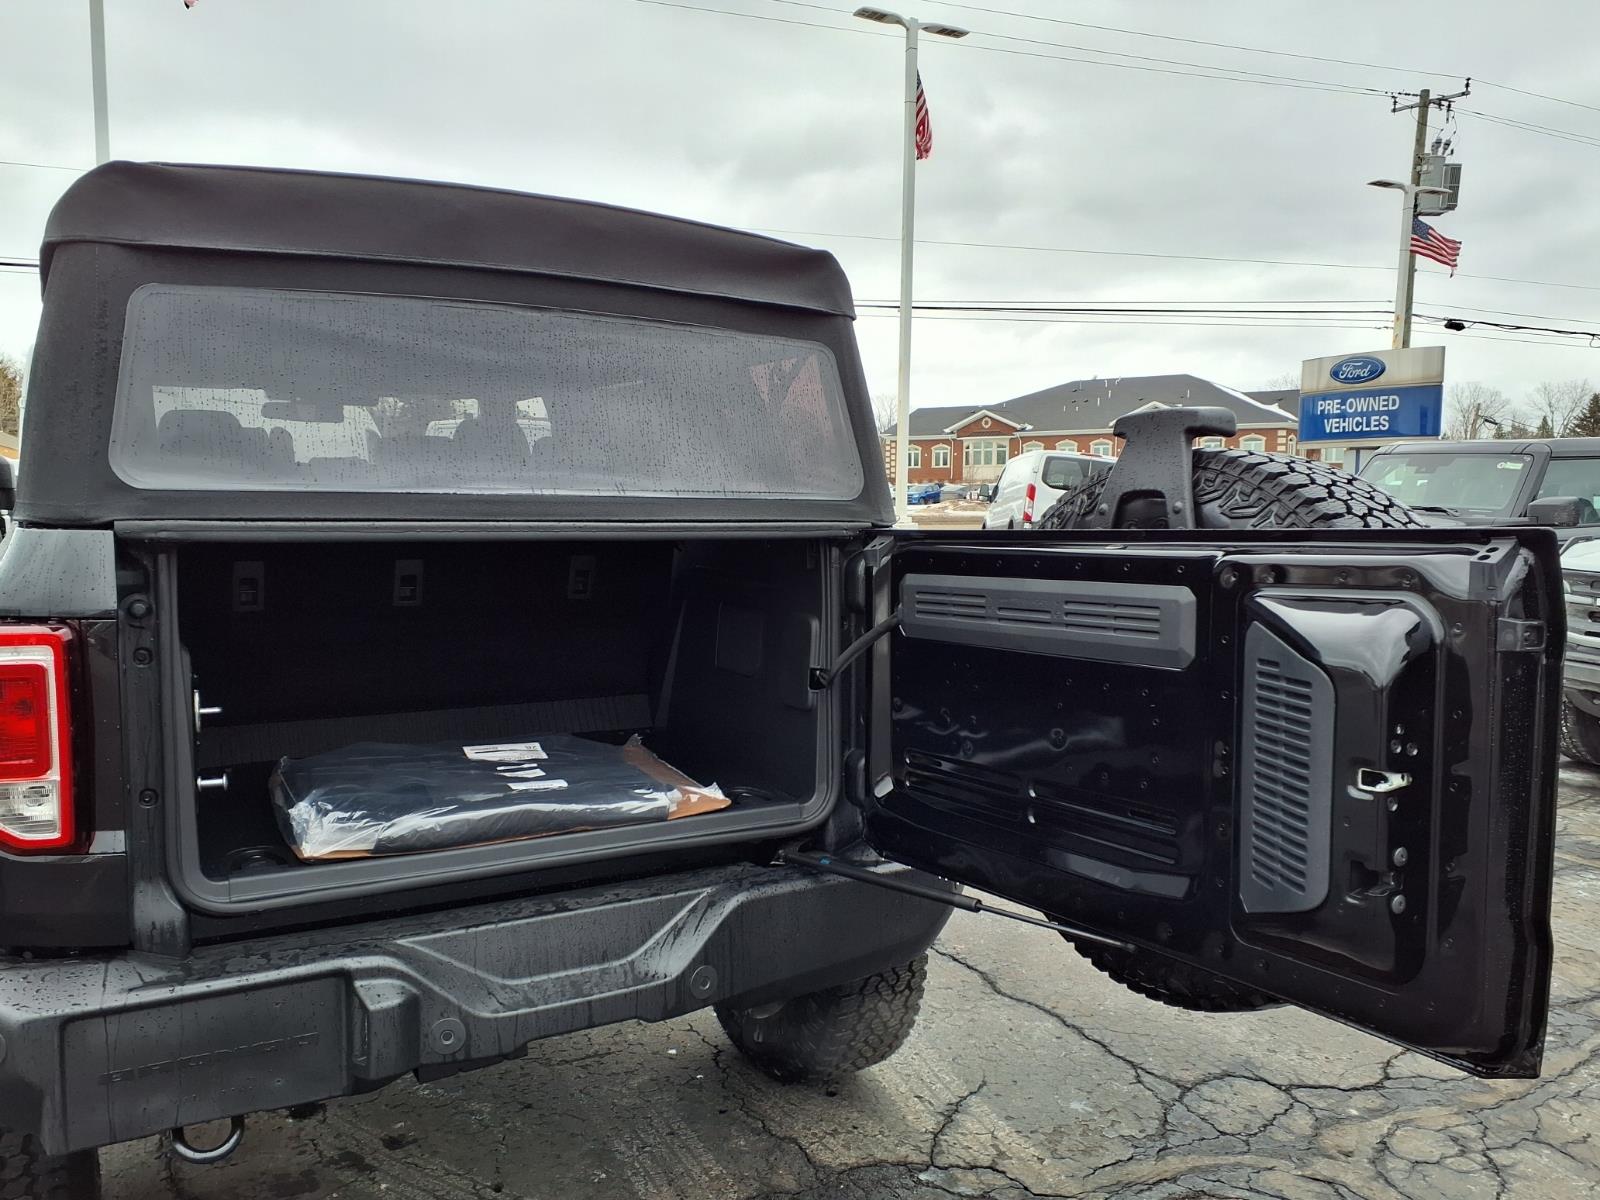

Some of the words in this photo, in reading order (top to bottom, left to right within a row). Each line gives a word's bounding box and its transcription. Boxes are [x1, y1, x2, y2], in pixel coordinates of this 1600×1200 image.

[1339, 361, 1371, 379] Ford
[1318, 395, 1400, 415] PRE-OWNED
[1324, 416, 1390, 433] VEHICLES
